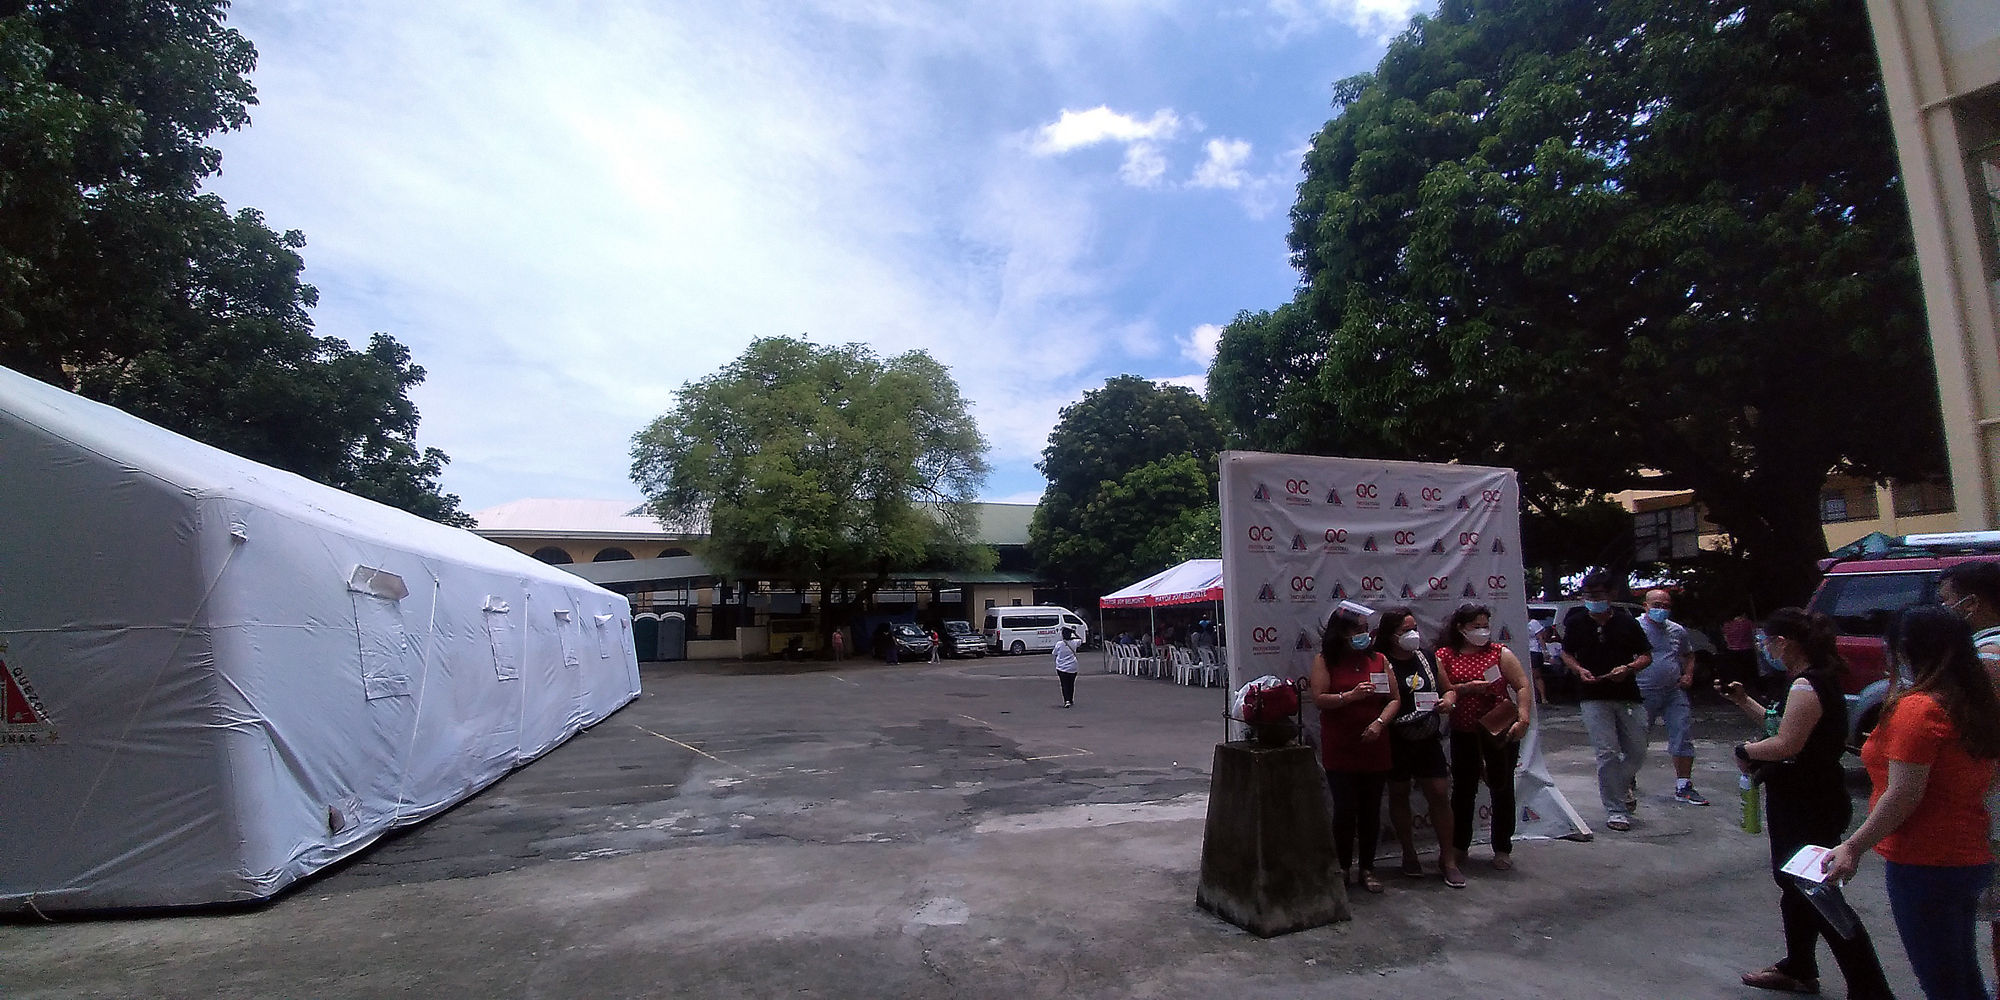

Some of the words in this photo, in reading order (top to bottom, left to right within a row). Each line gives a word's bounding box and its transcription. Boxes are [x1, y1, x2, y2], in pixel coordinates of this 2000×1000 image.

[1285, 479, 1309, 495] QC
[1356, 483, 1378, 499] QC
[1421, 487, 1442, 502] QC
[1482, 489, 1501, 503] QC
[1248, 526, 1273, 541] QC
[1324, 528, 1348, 544] QC
[1394, 530, 1416, 545] QC
[1459, 532, 1480, 546] QC
[1291, 576, 1315, 591] QC
[1361, 576, 1384, 591] QC
[1428, 576, 1448, 590] QC
[1487, 575, 1507, 589] QC
[1252, 626, 1278, 643] QC
[13, 667, 49, 721] QUEZON
